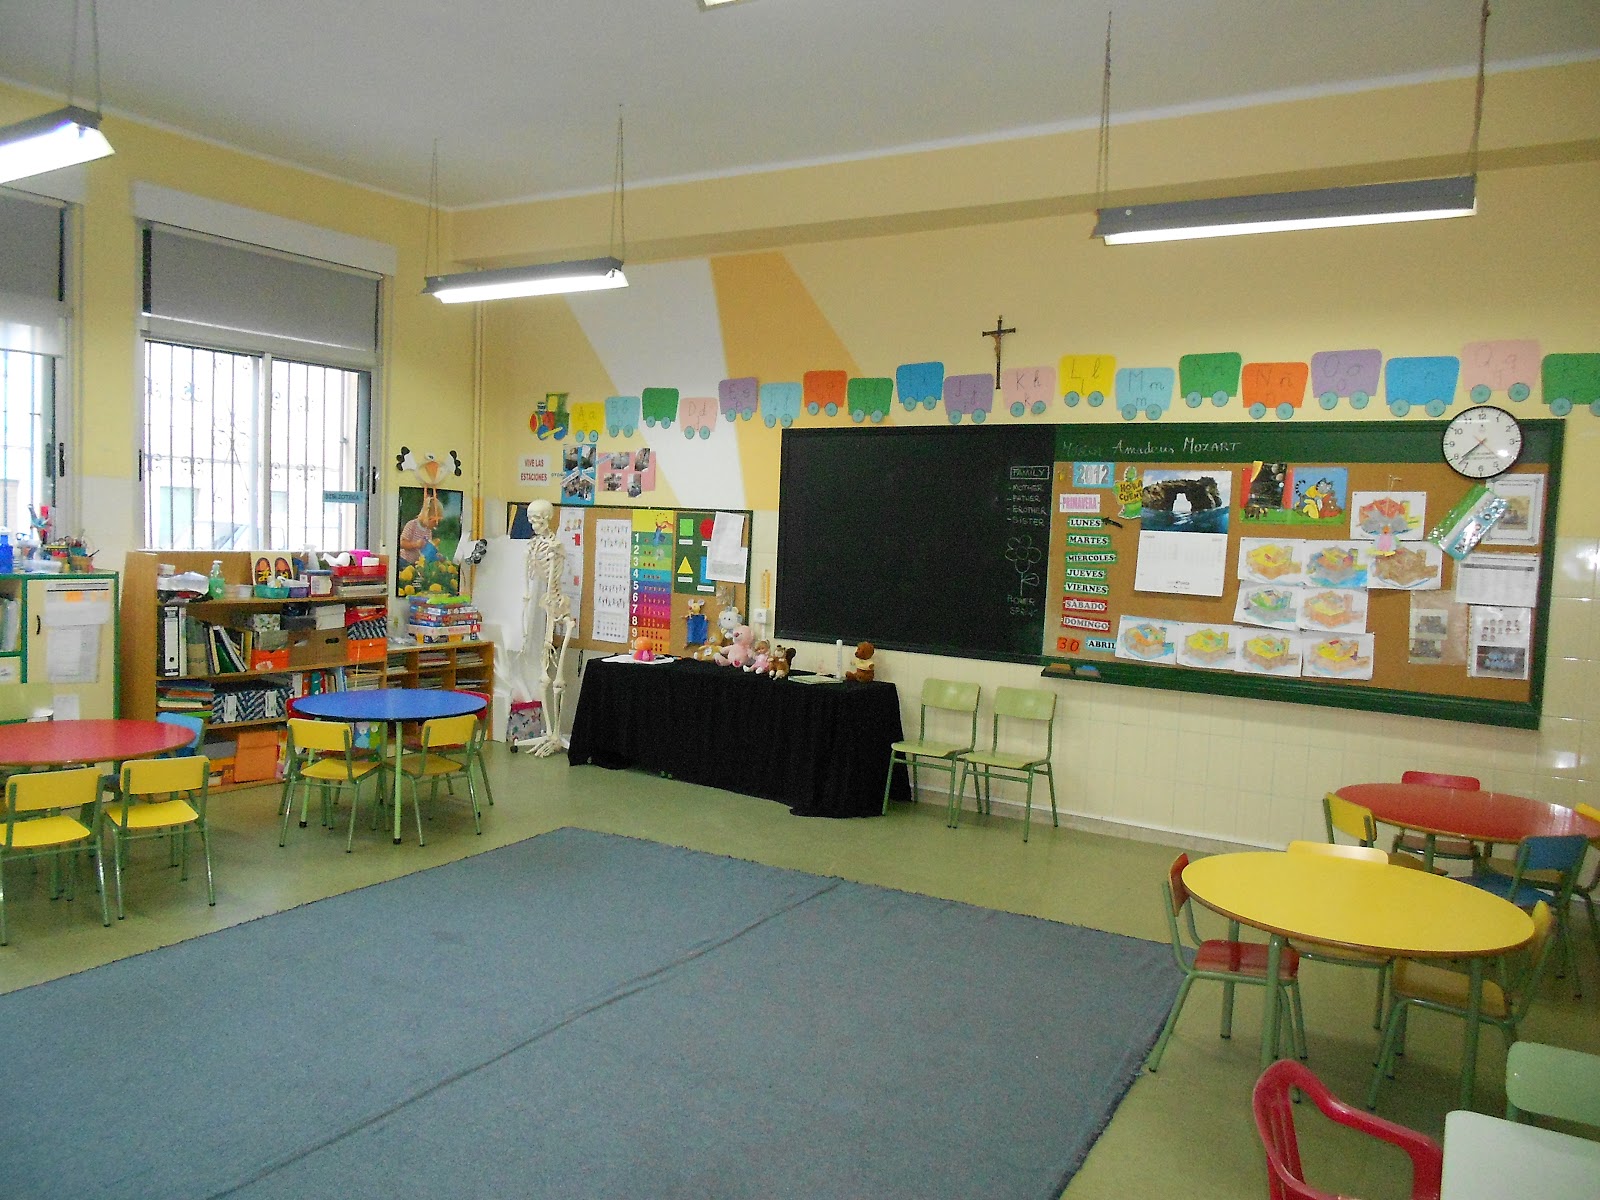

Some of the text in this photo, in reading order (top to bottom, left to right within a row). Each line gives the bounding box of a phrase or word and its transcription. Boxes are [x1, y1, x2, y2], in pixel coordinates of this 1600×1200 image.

[1112, 439, 1175, 455] Amadeus
[1182, 437, 1242, 455] MOZART
[524, 459, 544, 467] VIVE LAS
[520, 473, 548, 481] ESTACIONES
[1012, 468, 1045, 477] FAMILY
[1077, 464, 1110, 484] 2012
[1062, 497, 1097, 510] PRIMAVERA
[1071, 519, 1101, 527] LUNES
[634, 533, 639, 542] 1
[1069, 536, 1108, 545] MARTES
[633, 545, 640, 555] 2
[633, 556, 639, 567] 3
[633, 569, 639, 579] 4
[1067, 569, 1104, 578] JUEVES
[633, 580, 639, 590] 5
[1067, 583, 1107, 594] VIERNES
[632, 592, 639, 602] 6
[632, 604, 638, 614] 7
[631, 615, 638, 626] 8
[1064, 617, 1108, 629] DOMINGO
[631, 628, 638, 638] 9
[1059, 637, 1116, 652] 30 ABRIL
